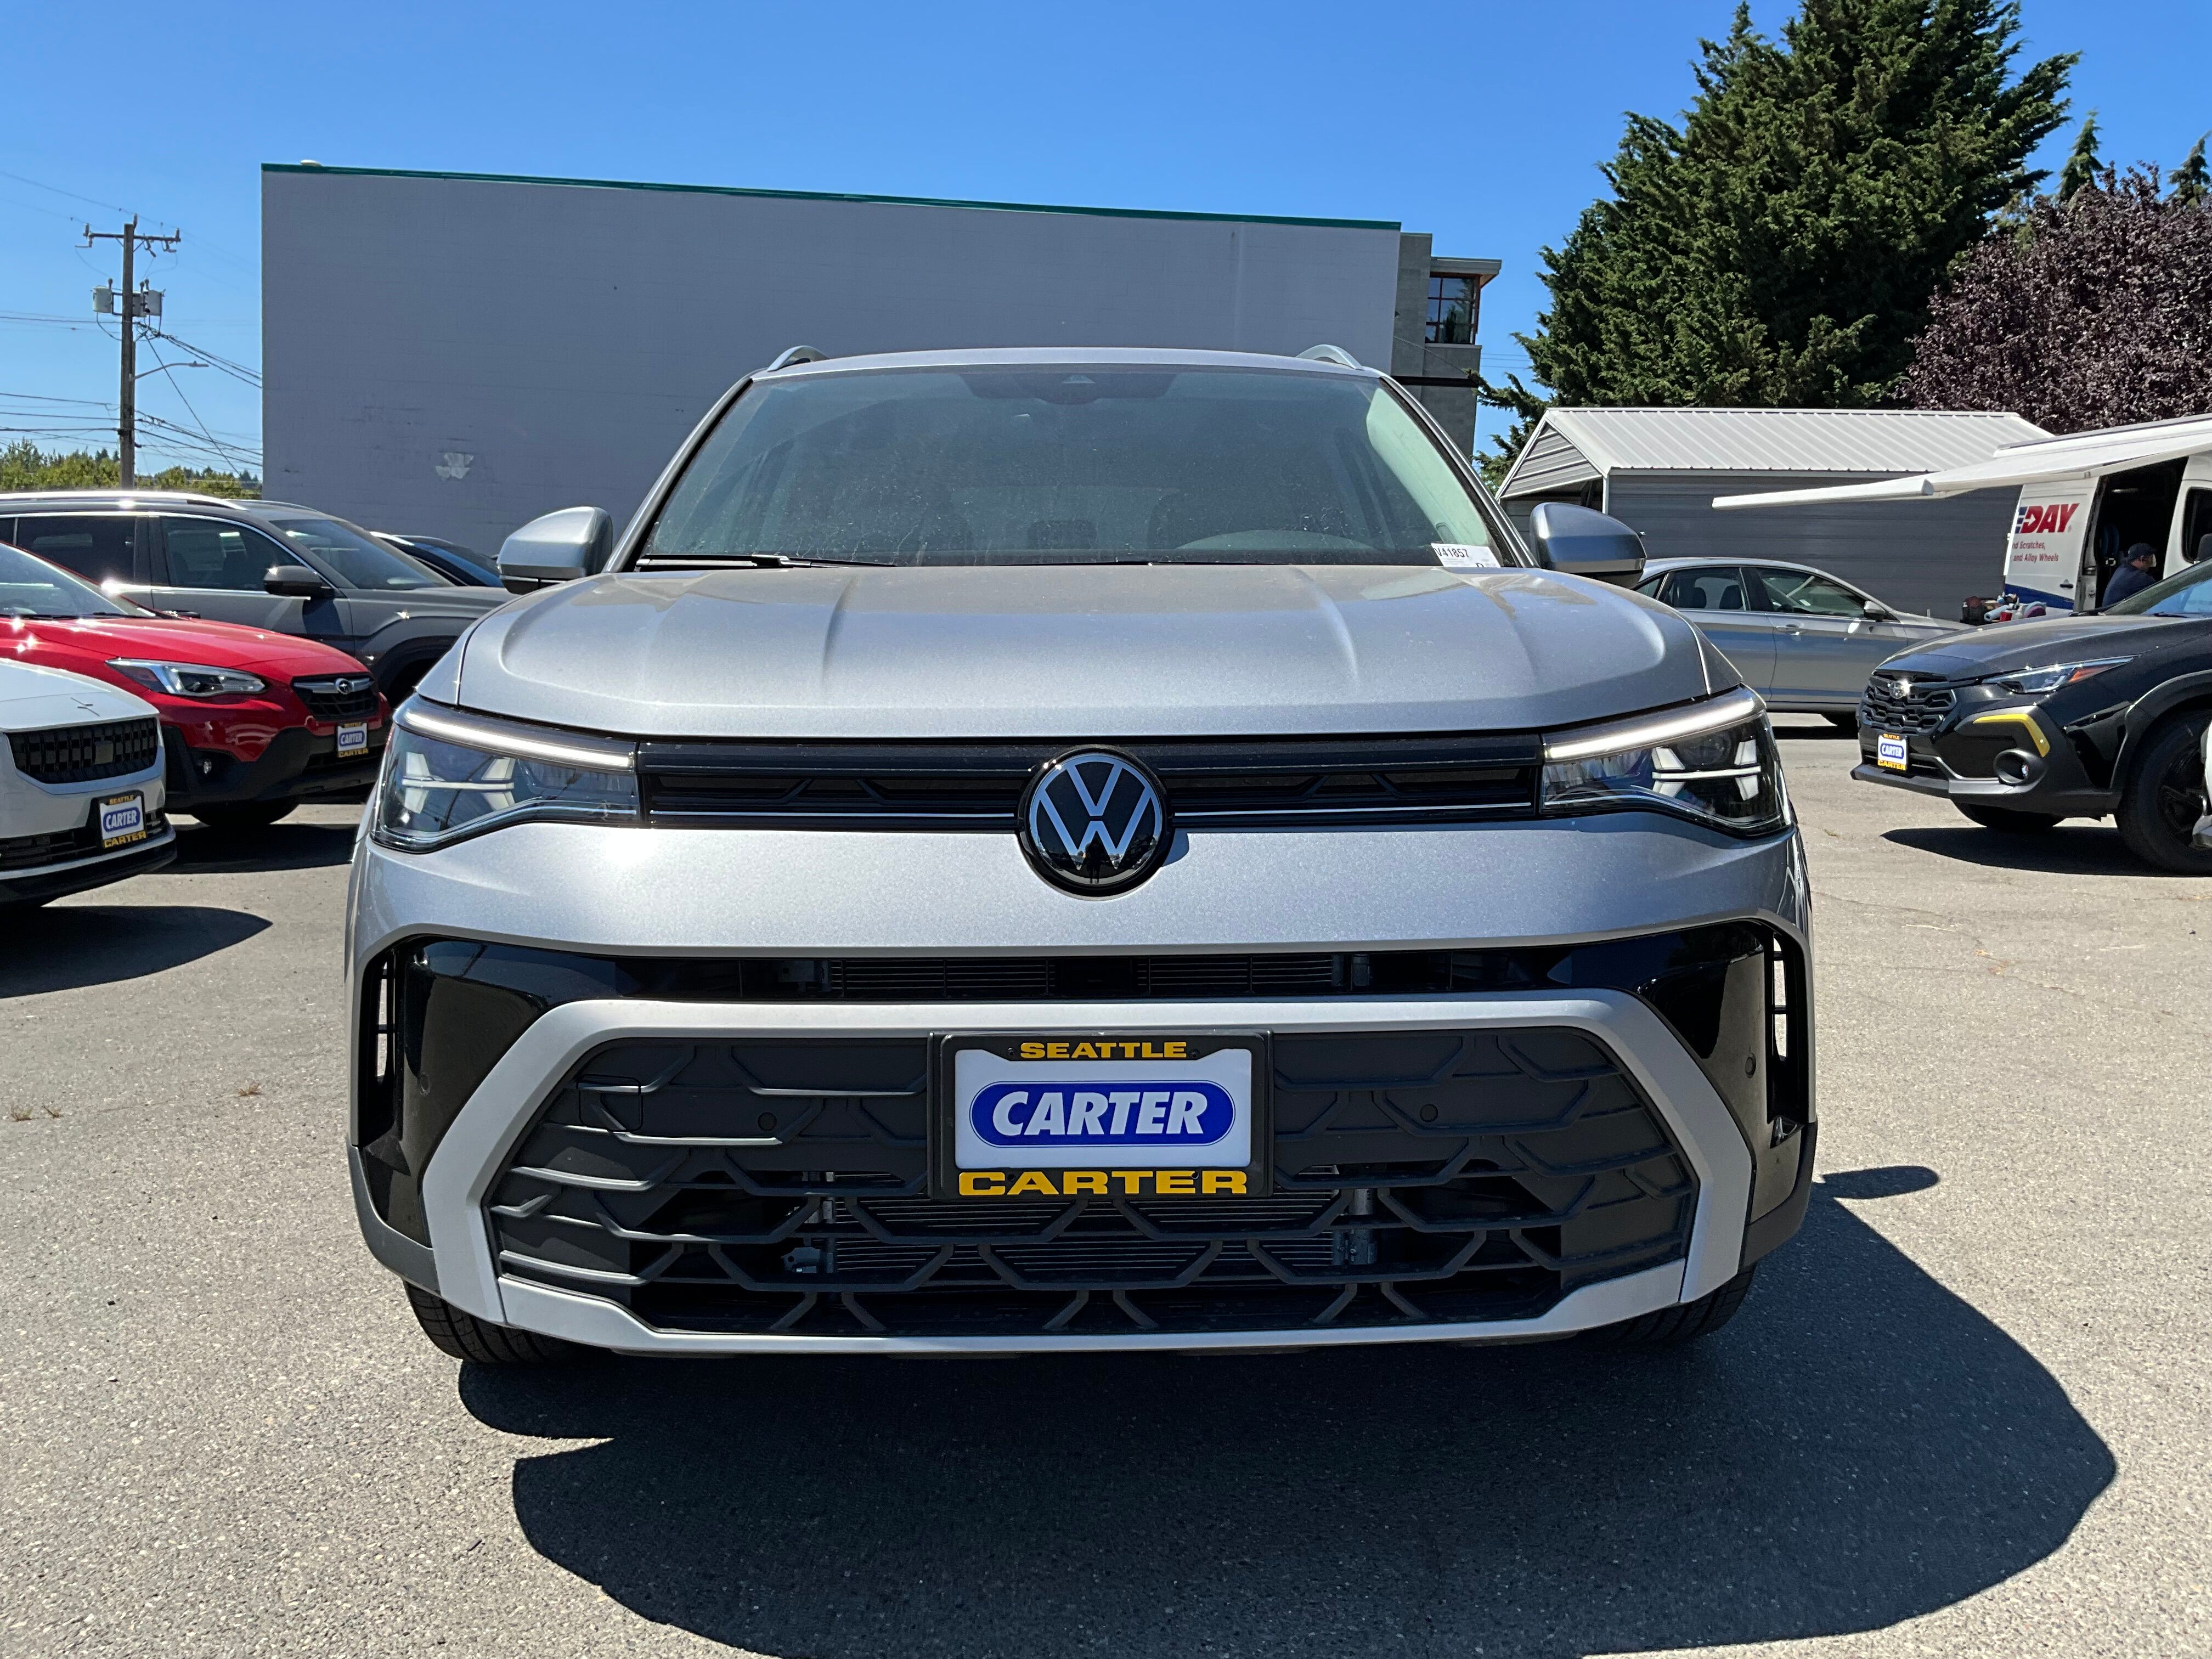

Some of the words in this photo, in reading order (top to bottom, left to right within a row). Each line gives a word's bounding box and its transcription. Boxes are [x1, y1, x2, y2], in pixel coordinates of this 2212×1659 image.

[2019, 540, 2045, 550] Scratches,
[2024, 553, 2038, 563] Alloy
[2039, 552, 2059, 562] Wheels
[340, 732, 363, 745] CARTER
[1881, 744, 1903, 758] CARTER
[1877, 759, 1906, 771] CARTER
[109, 794, 134, 805] SEATTLE
[105, 810, 137, 830] CARTER
[104, 830, 147, 849] CARTER
[1020, 1041, 1187, 1059] SEATTLE
[992, 1091, 1208, 1136] CARTER
[958, 1170, 1247, 1196] CARTER
